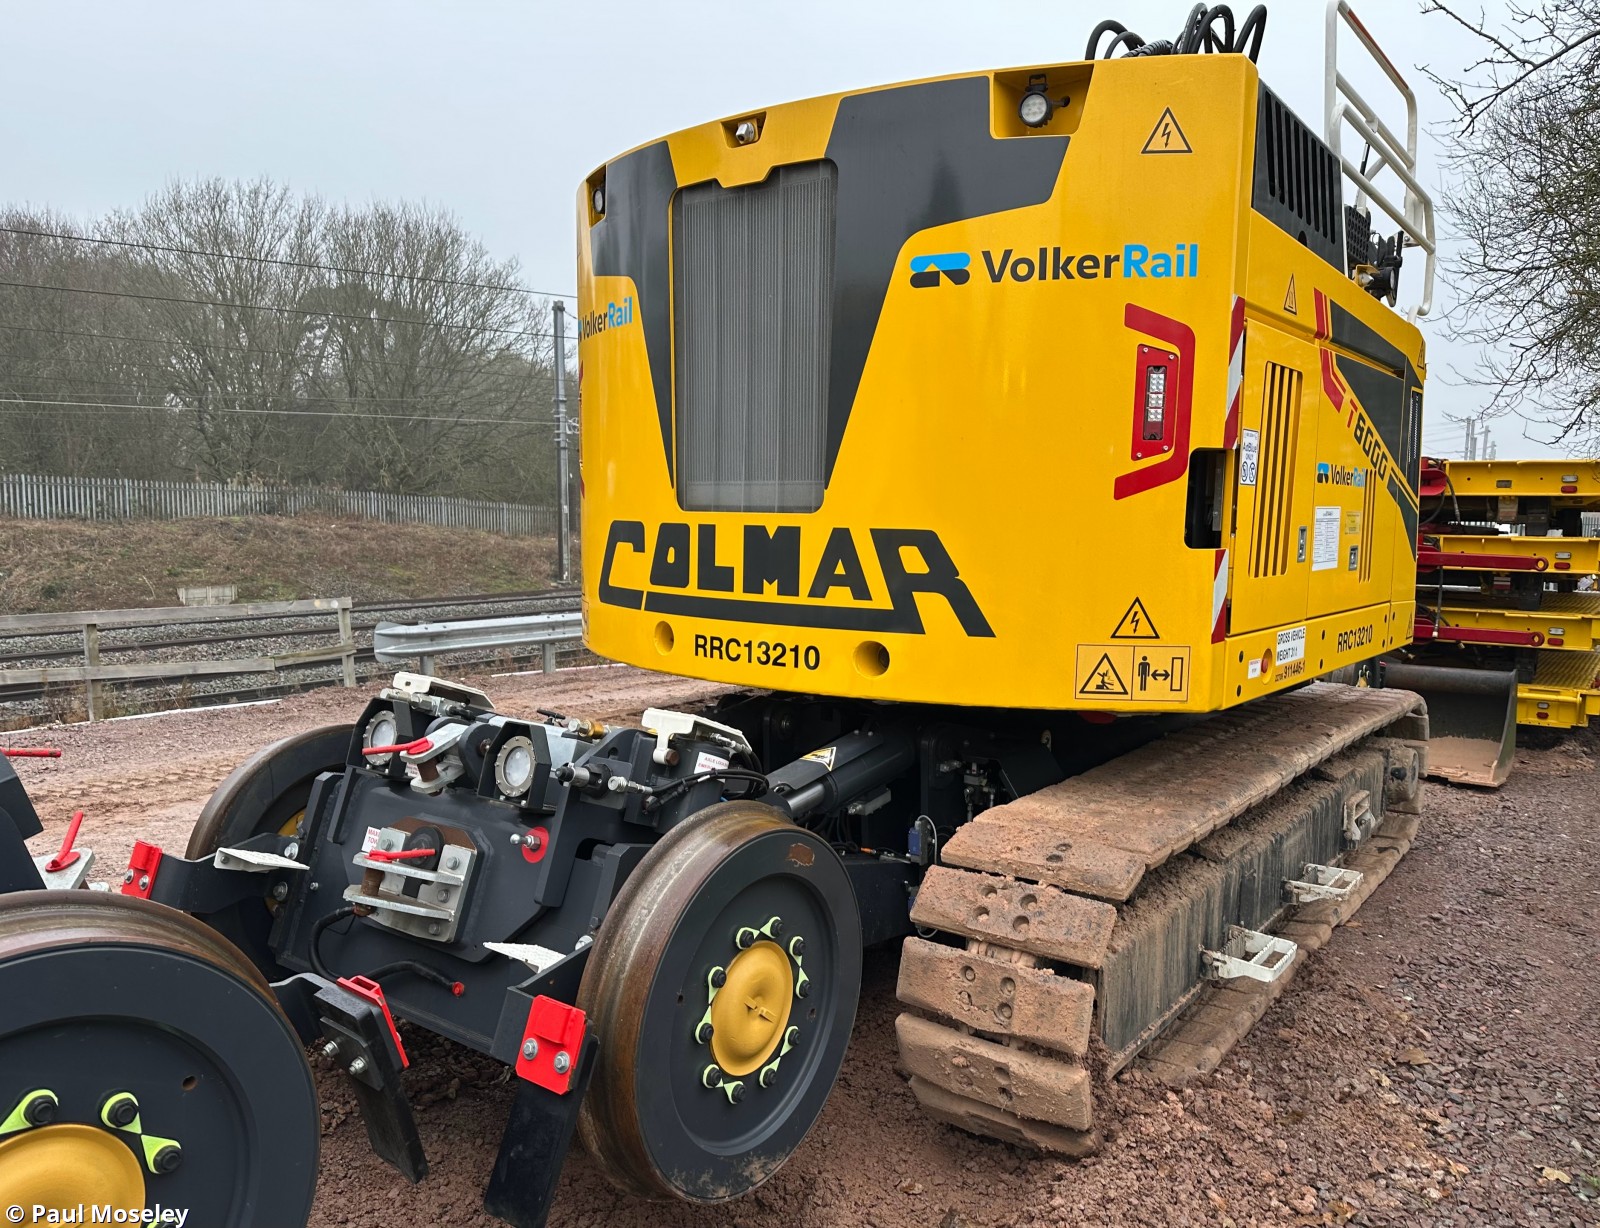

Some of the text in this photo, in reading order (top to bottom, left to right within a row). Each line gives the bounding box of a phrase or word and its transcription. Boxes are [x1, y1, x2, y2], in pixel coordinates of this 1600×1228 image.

[981, 244, 1198, 283] VolkerRail
[582, 296, 633, 340] VolkerRail
[1347, 398, 1388, 481] T6000
[1331, 463, 1365, 487] VolkerRail
[598, 520, 997, 638] COLMAR
[694, 634, 820, 671] RRC13210
[1337, 624, 1373, 654] RRC13210
